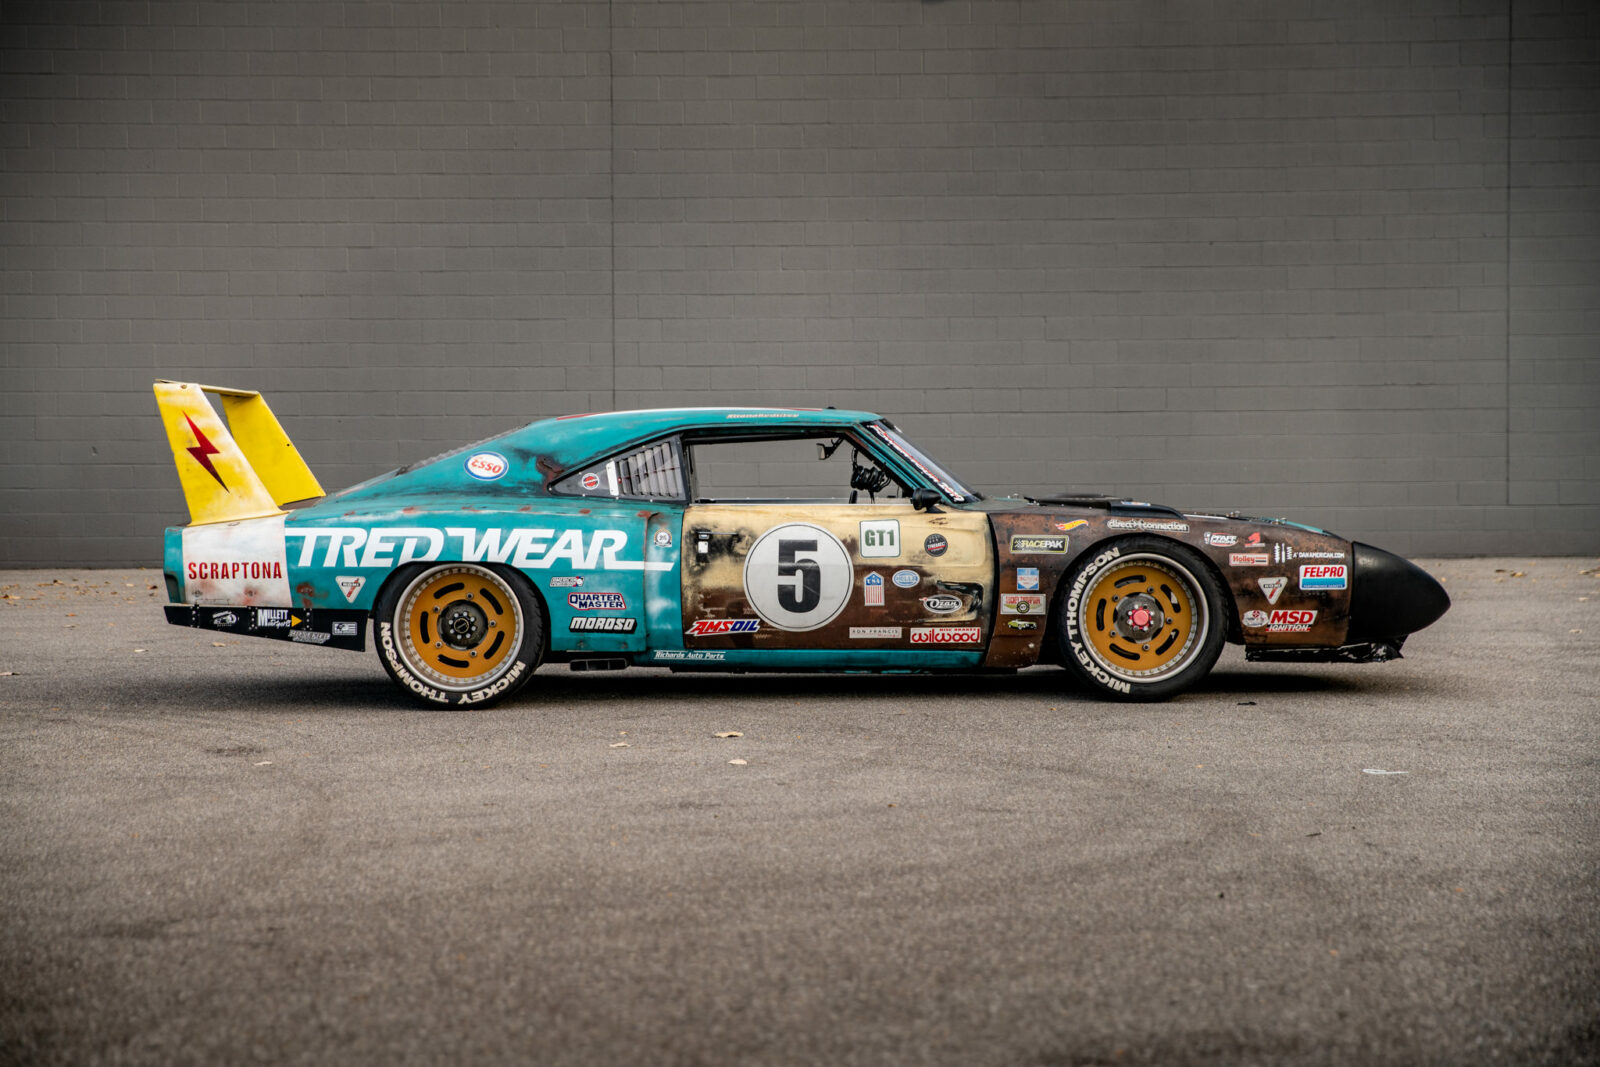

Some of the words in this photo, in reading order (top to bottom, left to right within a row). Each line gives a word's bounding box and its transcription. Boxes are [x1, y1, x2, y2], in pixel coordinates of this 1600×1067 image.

[864, 529, 896, 547] GT1
[1020, 539, 1064, 548] RACEPAK
[285, 527, 444, 568] TRED
[446, 527, 674, 571] WEAR
[1232, 555, 1256, 564] Holley
[188, 561, 282, 580] SCRAPTONA
[776, 539, 821, 614] 5
[1303, 566, 1344, 578] FEL-PRO
[569, 594, 621, 604] QUARTER
[1066, 546, 1121, 639] THOMPSON
[578, 600, 623, 609] MASTER
[257, 609, 288, 627] MILLETT
[570, 617, 635, 631] MOROSO
[1270, 610, 1314, 624] MSD
[692, 619, 760, 634] AMSOIL
[911, 628, 981, 643] wilwood
[380, 621, 450, 704] THOMPSON
[687, 652, 704, 660] Auto
[705, 652, 725, 660] Parts
[1071, 642, 1131, 694] MICKEY
[457, 660, 526, 705] MICKEY
